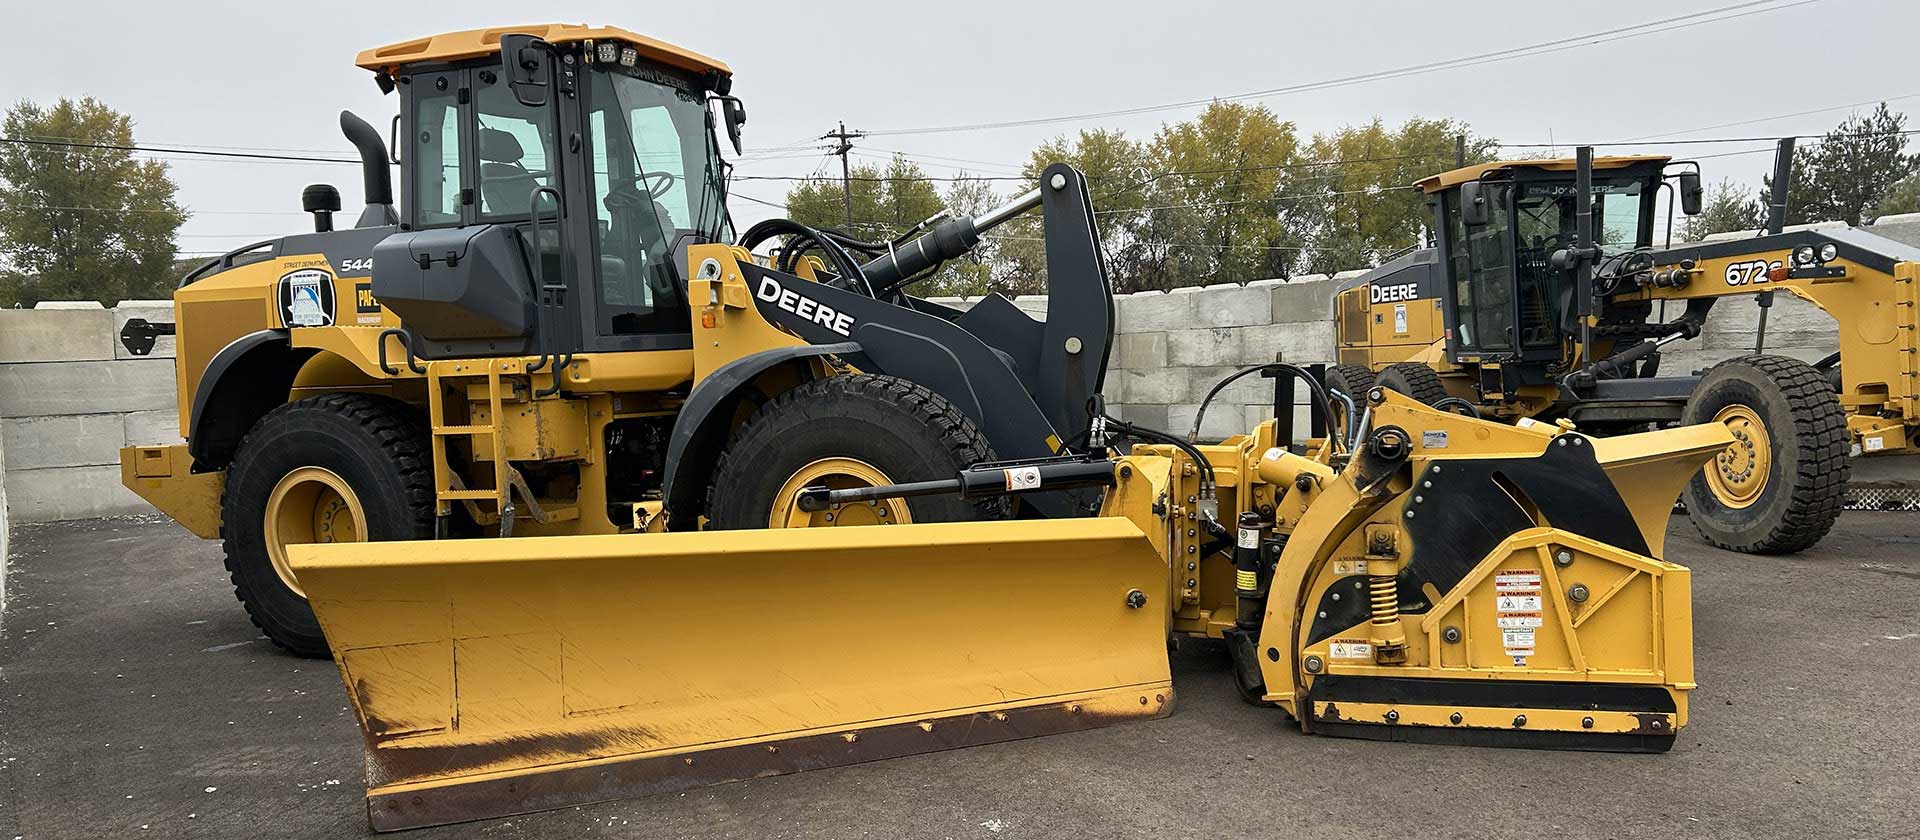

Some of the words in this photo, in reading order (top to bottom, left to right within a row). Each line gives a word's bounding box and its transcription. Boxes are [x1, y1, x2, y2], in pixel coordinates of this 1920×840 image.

[627, 65, 655, 81] JOHN
[655, 69, 690, 91] DEERE
[283, 261, 301, 269] STREET
[341, 258, 373, 272] 544
[1370, 283, 1418, 304] DEERE
[757, 275, 855, 337] DEERE
